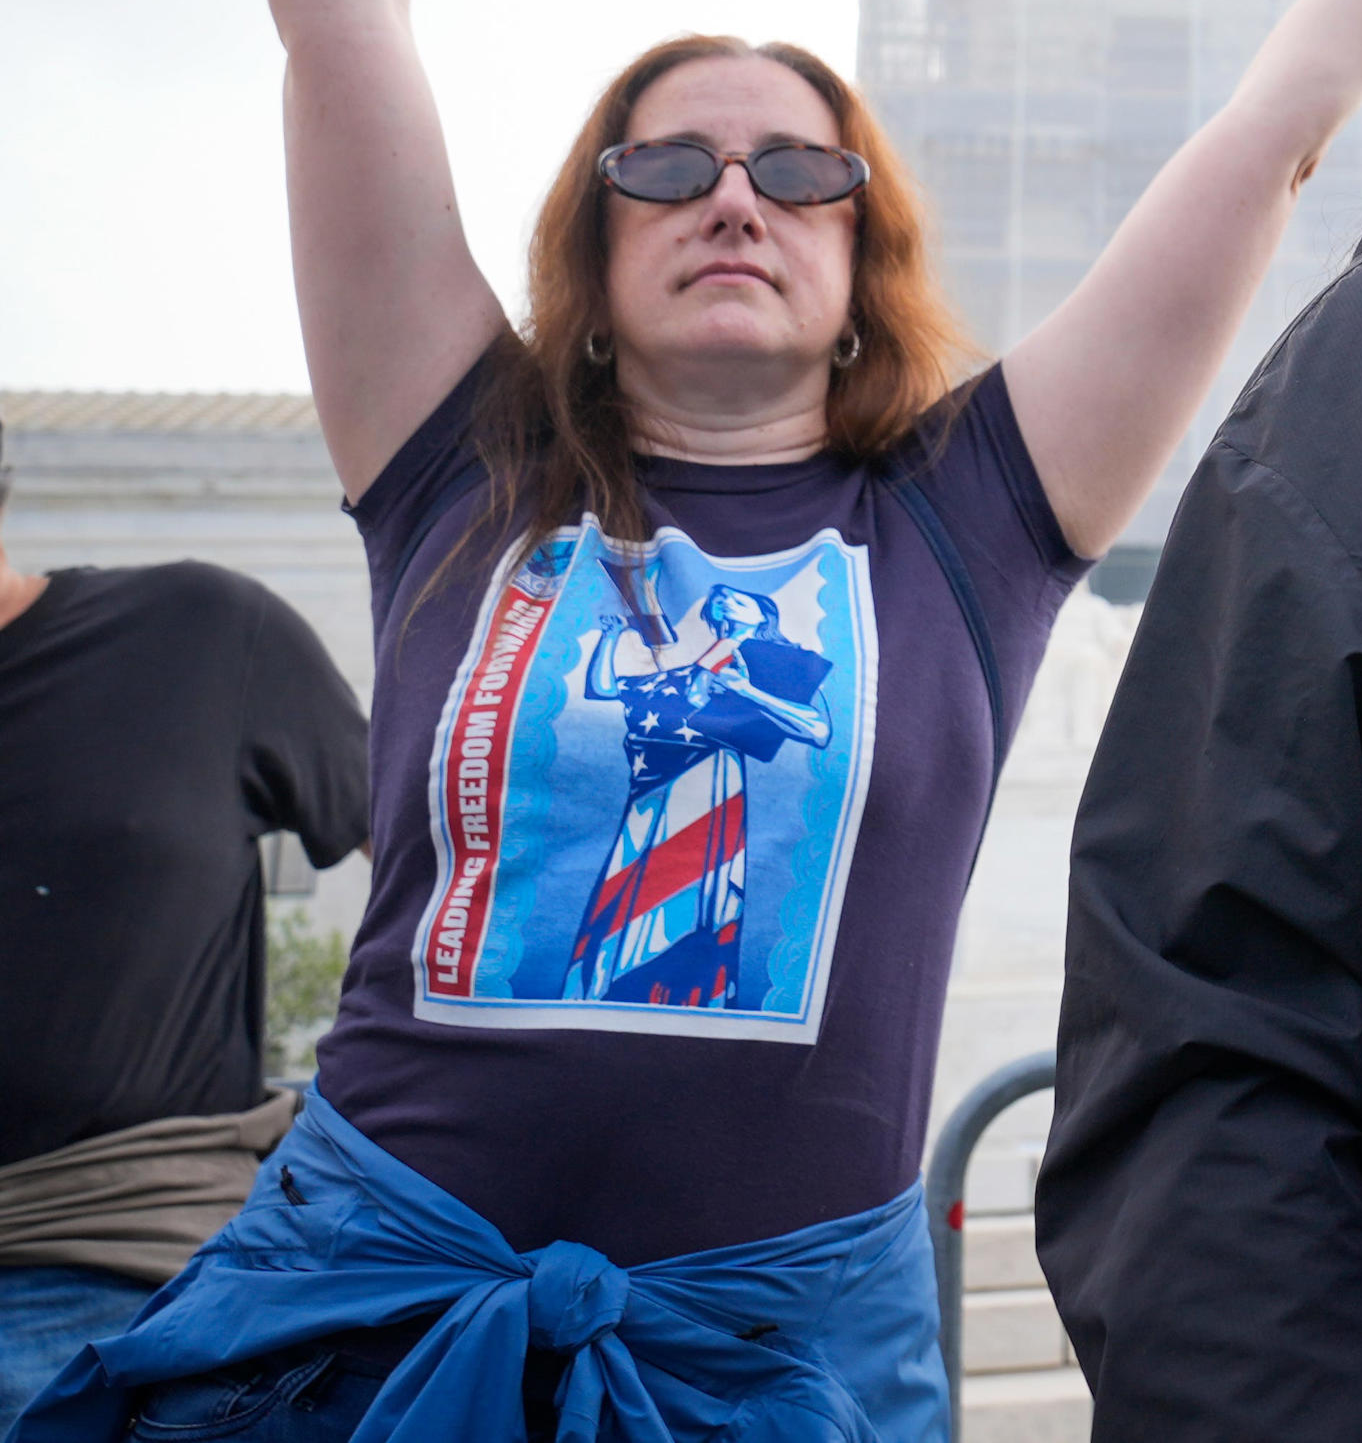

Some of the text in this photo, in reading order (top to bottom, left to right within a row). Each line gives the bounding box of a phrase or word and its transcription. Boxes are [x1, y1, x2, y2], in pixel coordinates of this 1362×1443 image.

[437, 599, 545, 985] LEADING FREEDOM FORWARD
